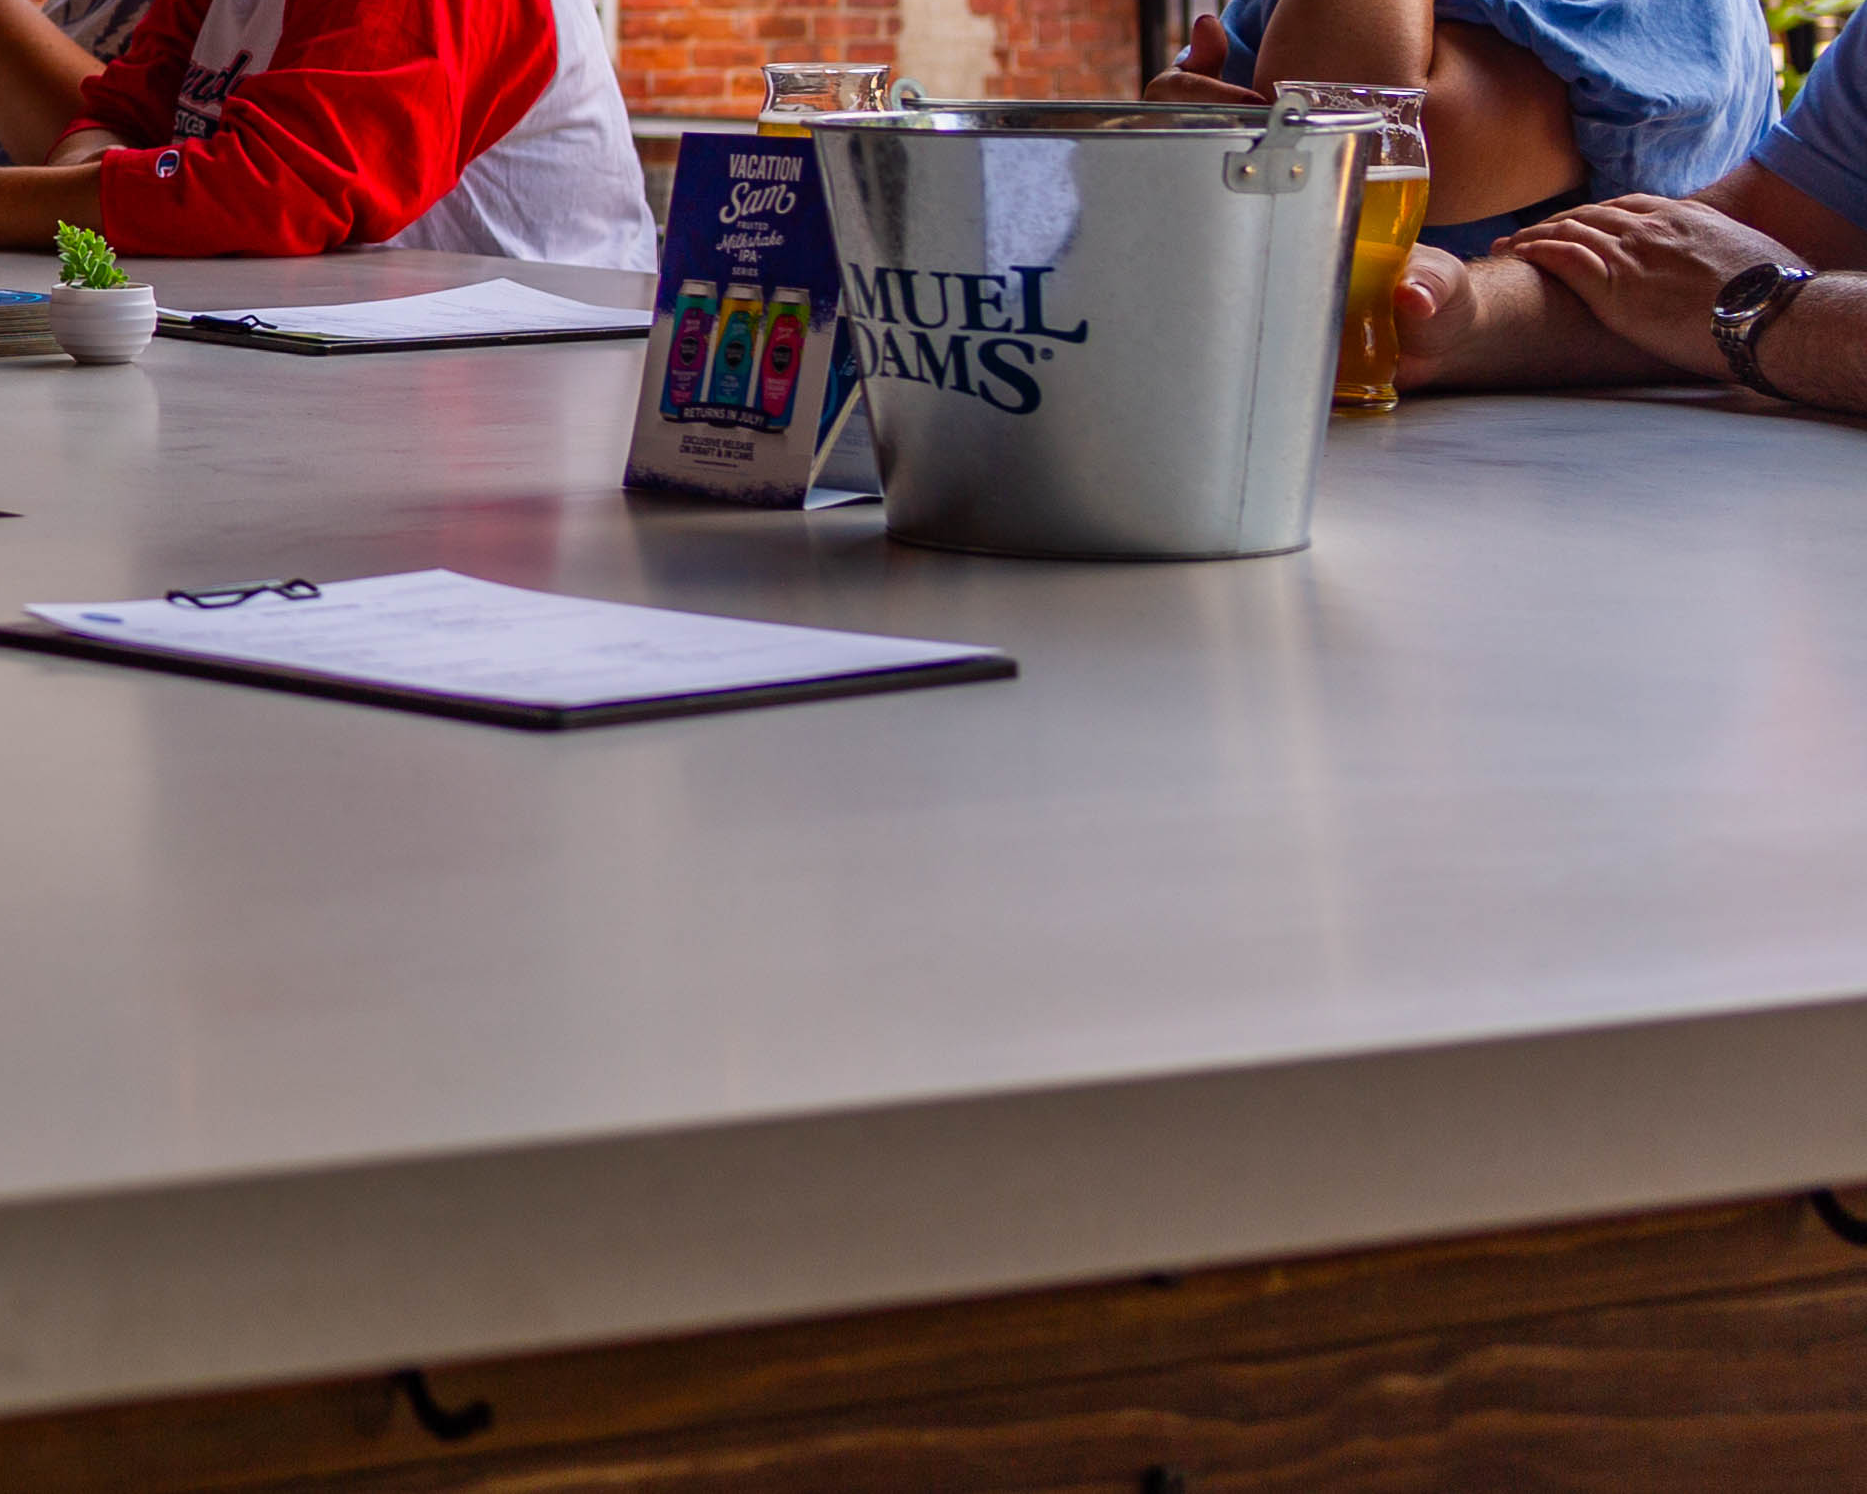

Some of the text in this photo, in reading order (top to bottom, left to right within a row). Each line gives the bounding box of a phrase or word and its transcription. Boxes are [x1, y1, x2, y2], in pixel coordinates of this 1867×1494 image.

[729, 153, 803, 182] VACATION
[719, 181, 796, 224] Sam
[716, 229, 785, 254] Milkshake
[683, 407, 726, 420] RETURNS
